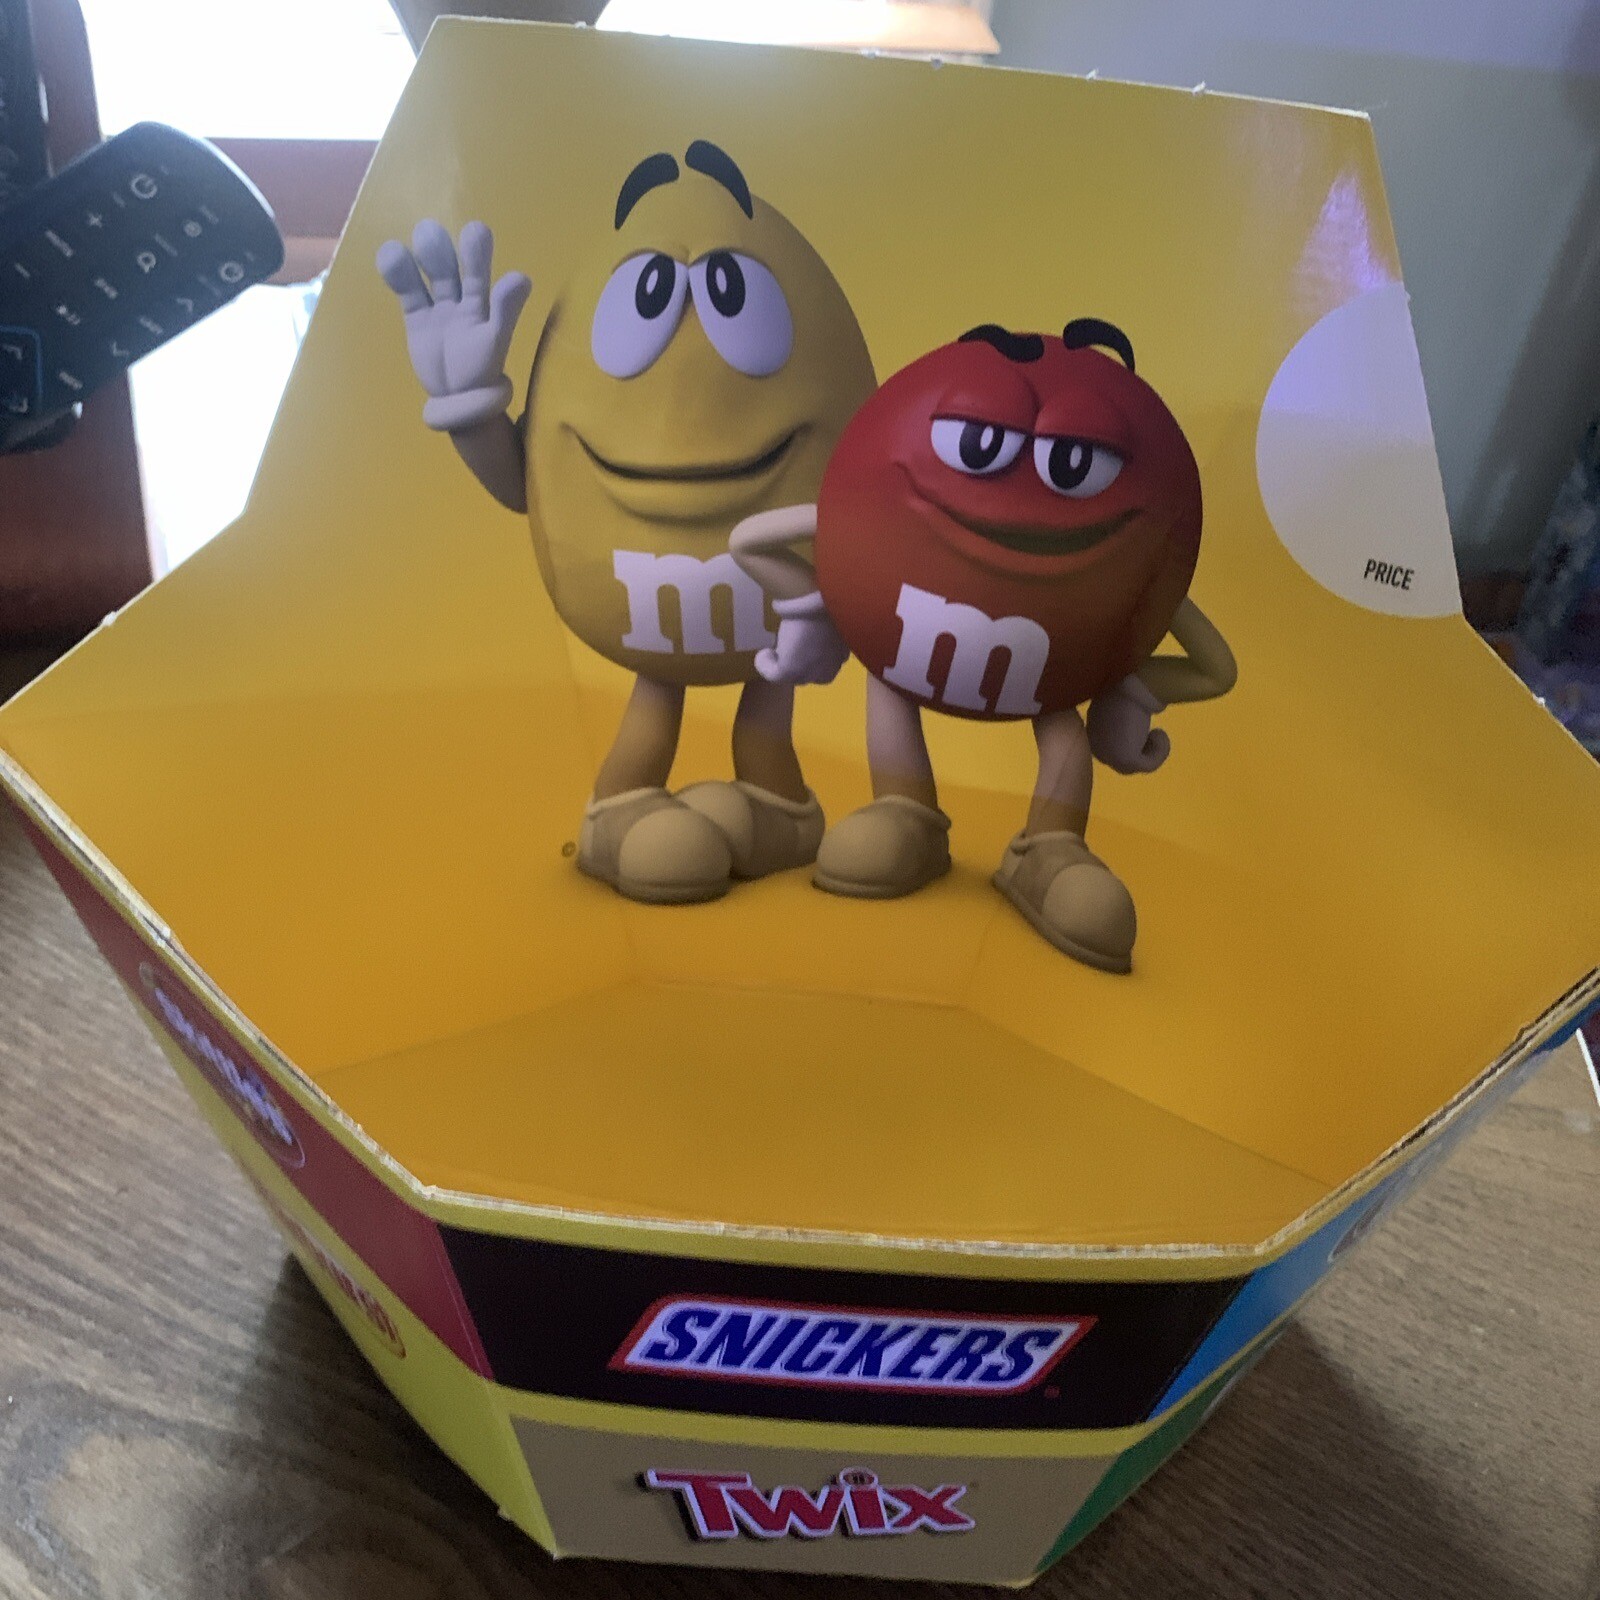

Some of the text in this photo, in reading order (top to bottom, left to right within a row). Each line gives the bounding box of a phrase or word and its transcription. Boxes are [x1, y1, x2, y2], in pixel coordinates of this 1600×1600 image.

[613, 550, 776, 654] m
[1363, 558, 1415, 591] PRICE
[883, 582, 1051, 716] m
[645, 1307, 1062, 1385] SNICKERS
[645, 1466, 976, 1539] Twix
